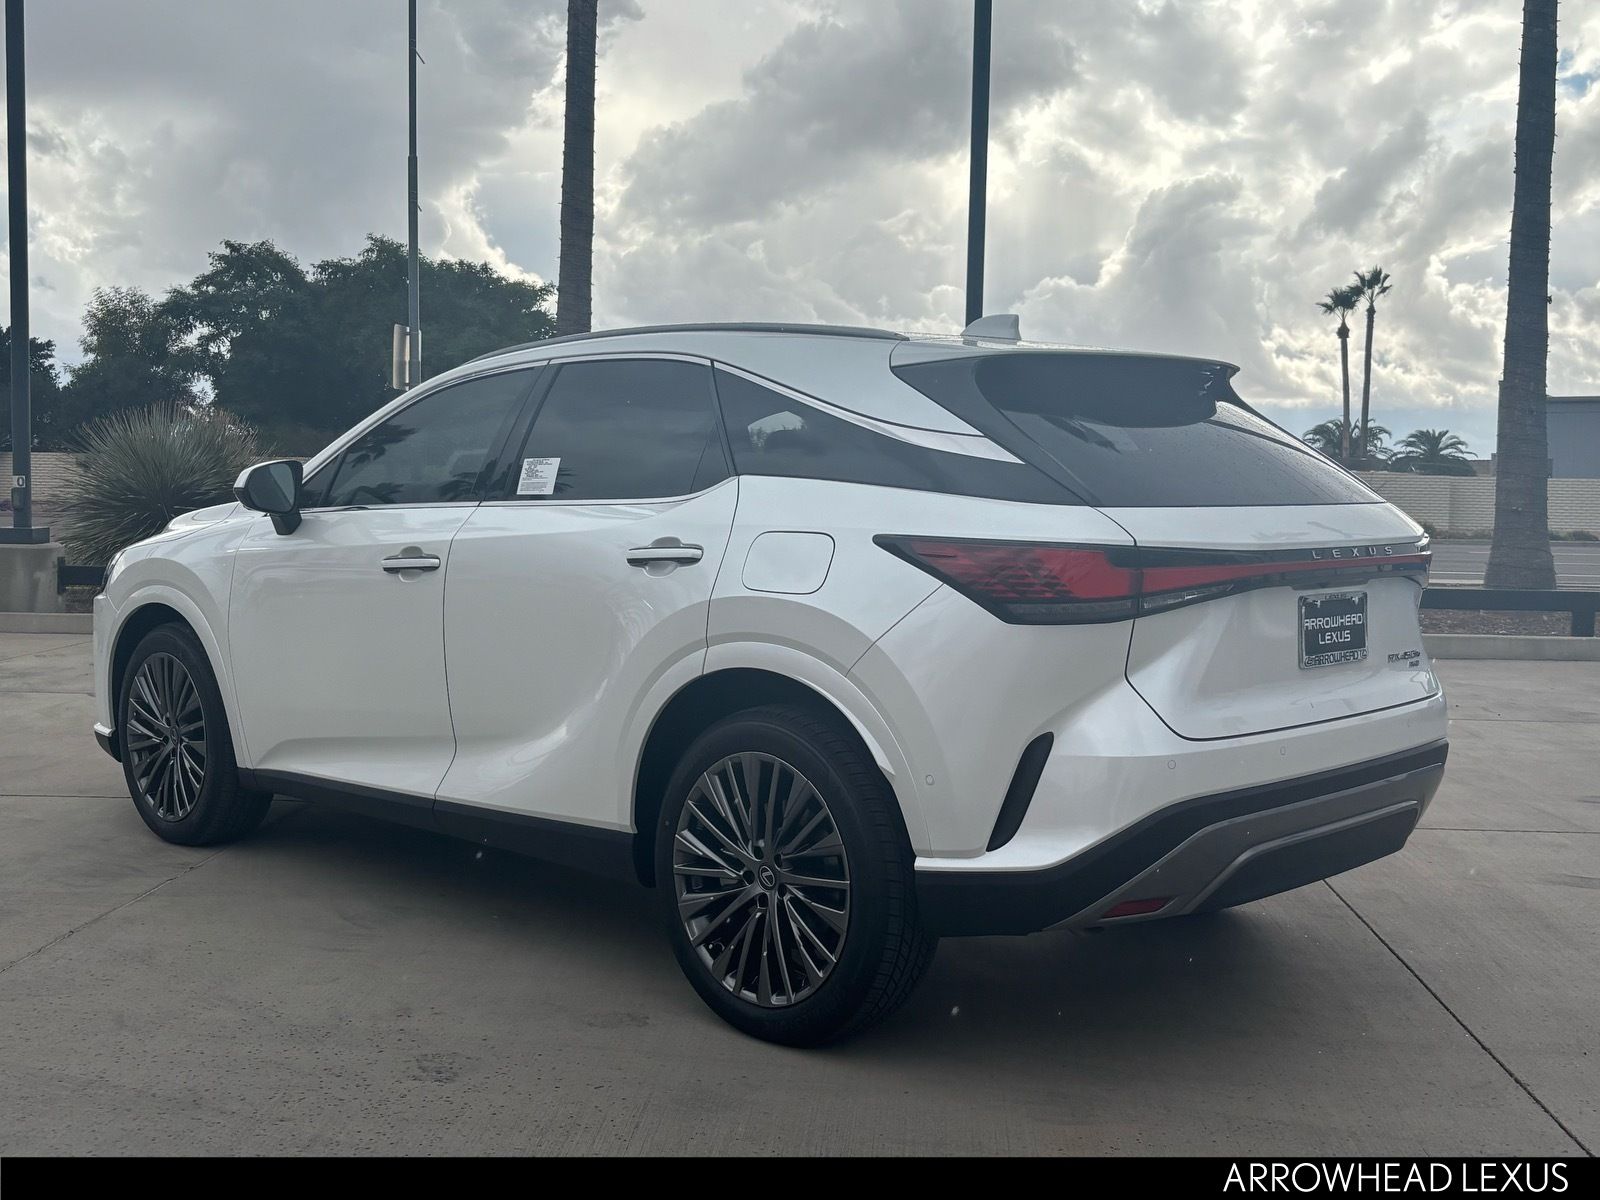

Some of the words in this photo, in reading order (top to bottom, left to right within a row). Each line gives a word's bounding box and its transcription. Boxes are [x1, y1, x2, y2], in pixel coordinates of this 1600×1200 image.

[1312, 546, 1393, 559] LEXUS
[1304, 613, 1363, 630] ARROWHEAD
[1318, 630, 1351, 645] LEXUS
